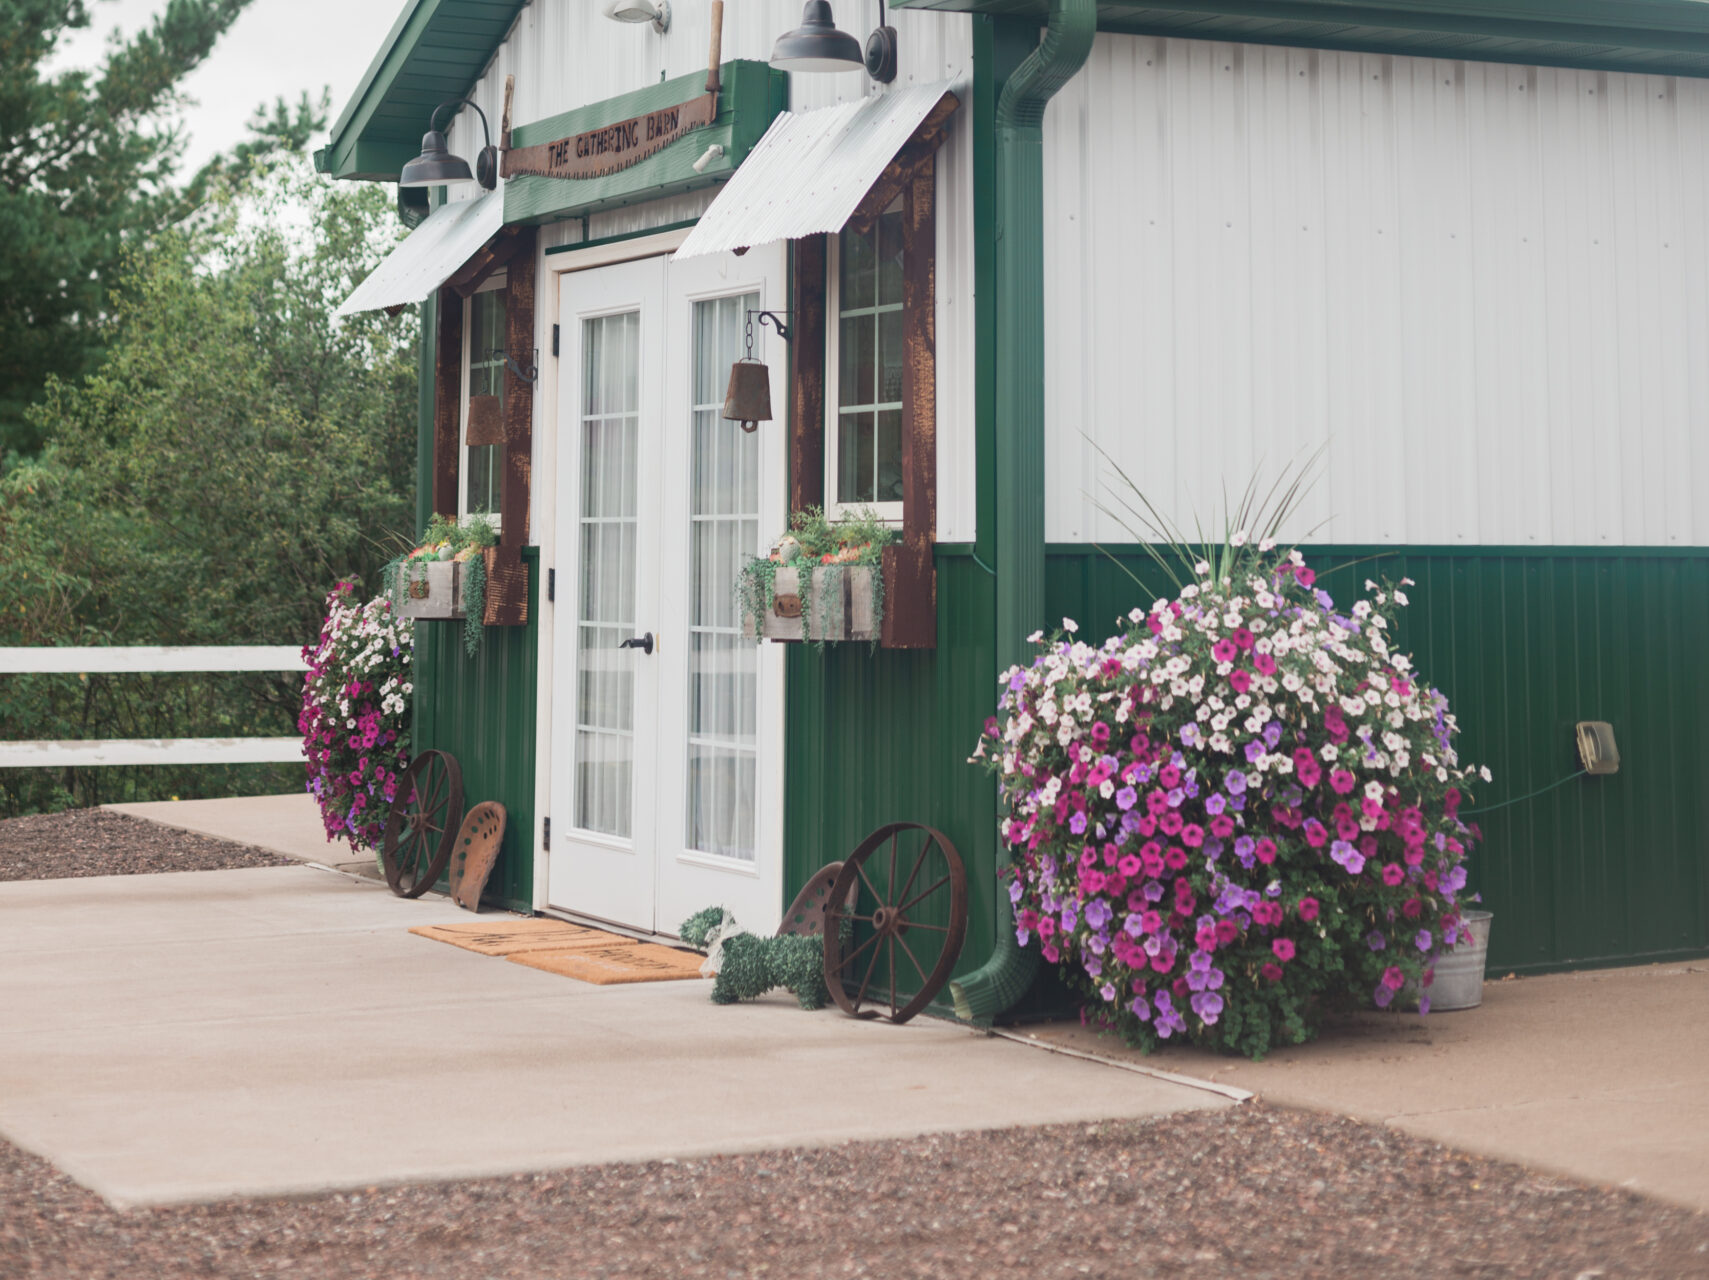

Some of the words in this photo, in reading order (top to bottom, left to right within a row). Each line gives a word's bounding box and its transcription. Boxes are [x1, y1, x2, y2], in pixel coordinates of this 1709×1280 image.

[549, 140, 569, 169] THE
[576, 121, 638, 158] GATHERING
[647, 109, 680, 141] BARN
